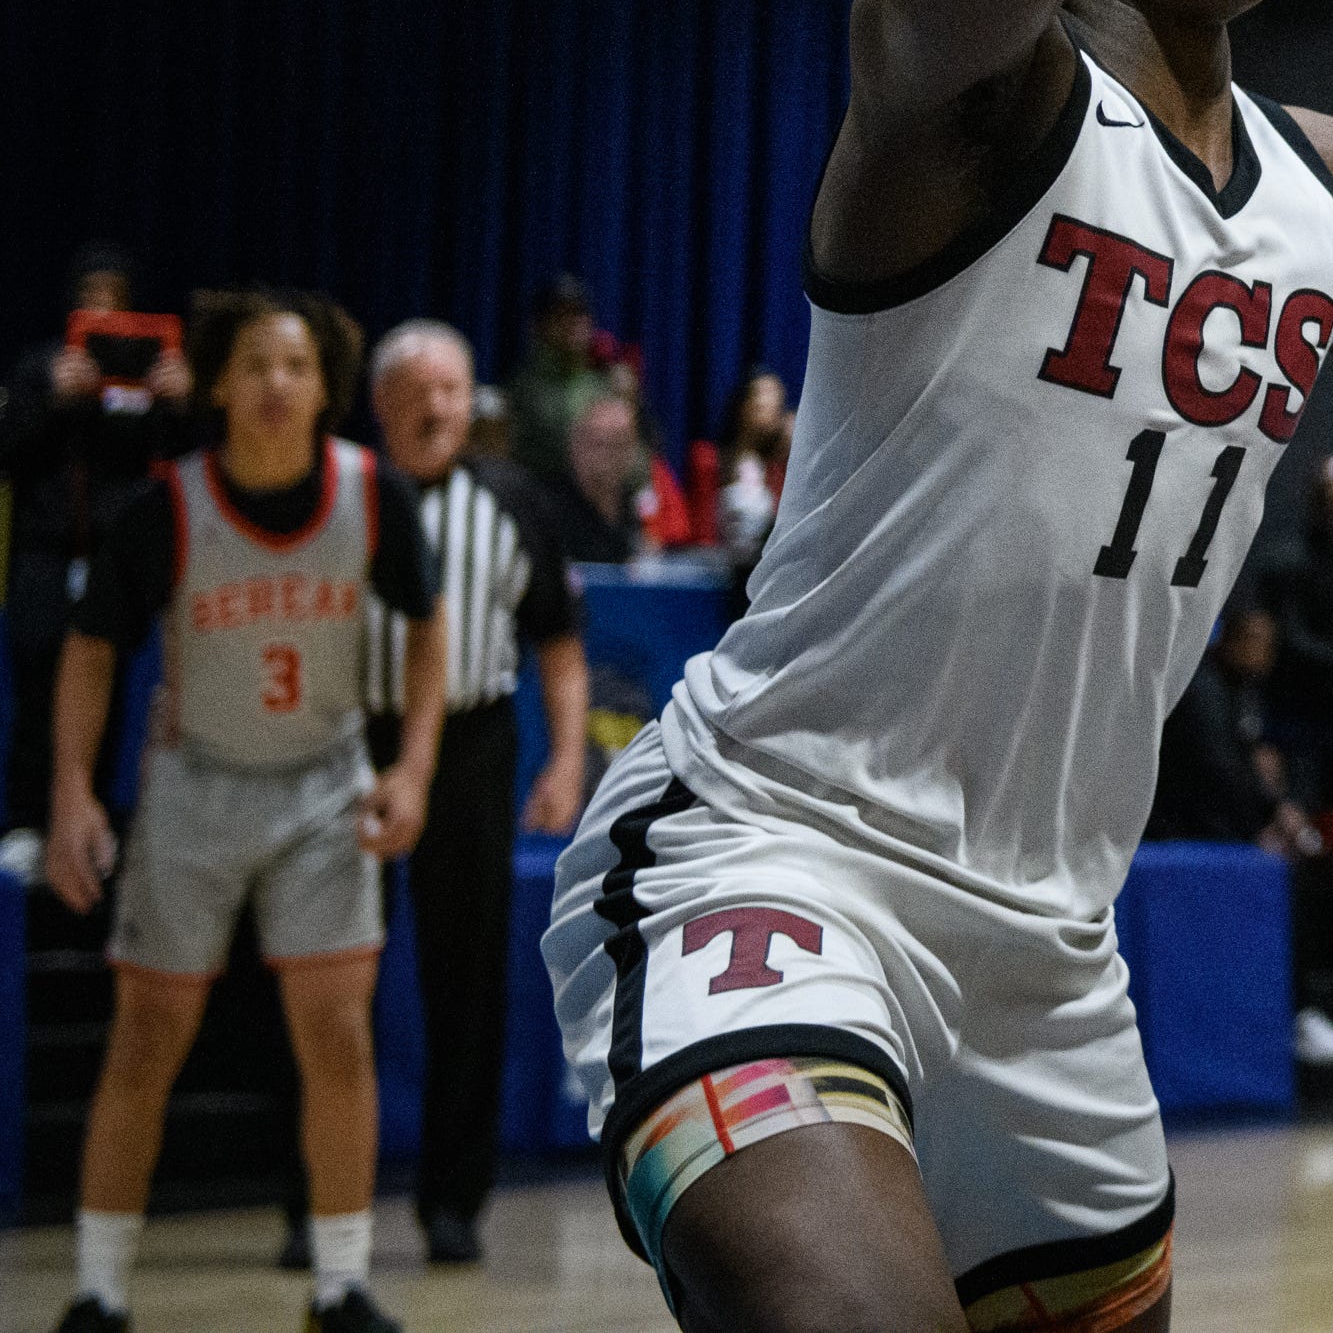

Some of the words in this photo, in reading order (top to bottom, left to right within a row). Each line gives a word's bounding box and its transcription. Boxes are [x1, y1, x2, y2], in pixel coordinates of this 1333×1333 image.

[1092, 428, 1247, 588] 11
[262, 643, 302, 712] 3
[681, 906, 823, 995] T
